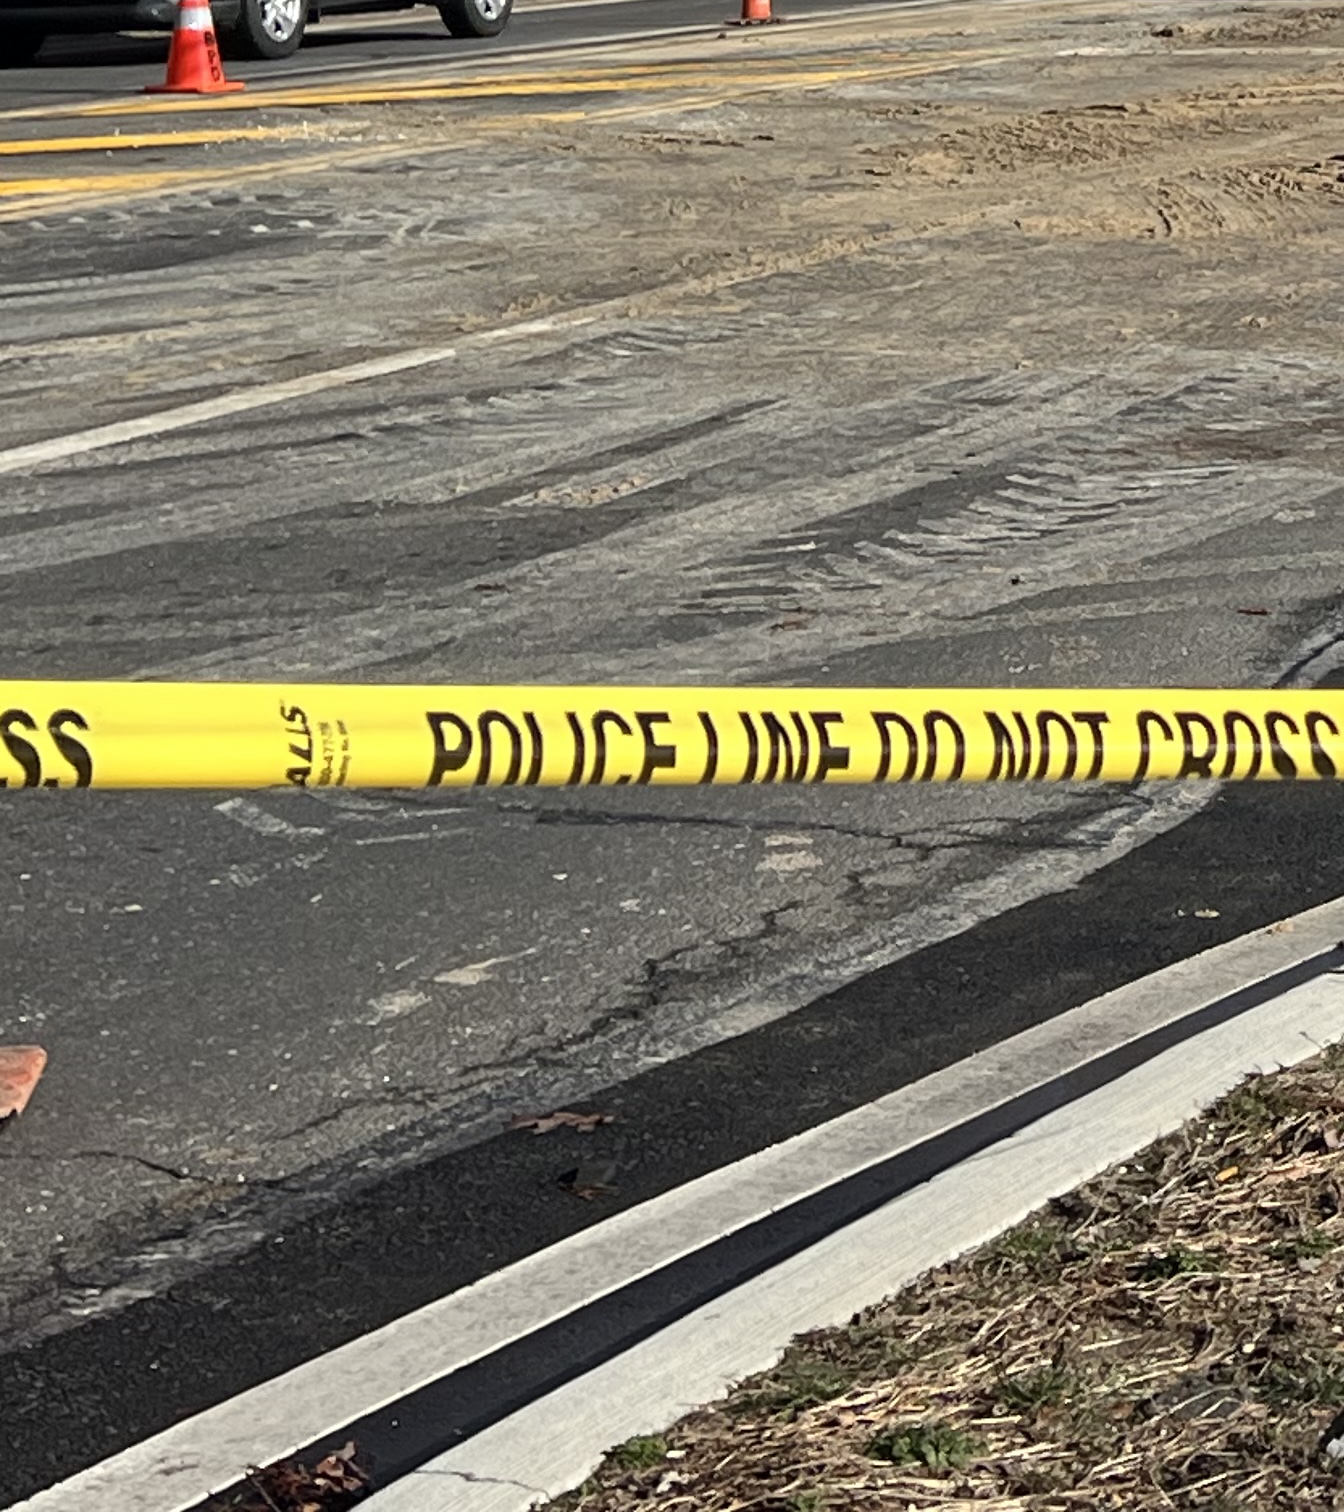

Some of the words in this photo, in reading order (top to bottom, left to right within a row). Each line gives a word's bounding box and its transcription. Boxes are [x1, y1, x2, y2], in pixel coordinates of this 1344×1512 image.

[426, 709, 677, 786] POLICE
[871, 710, 965, 782] DO
[984, 710, 1110, 781] NOT
[1135, 709, 1340, 781] CROSS
